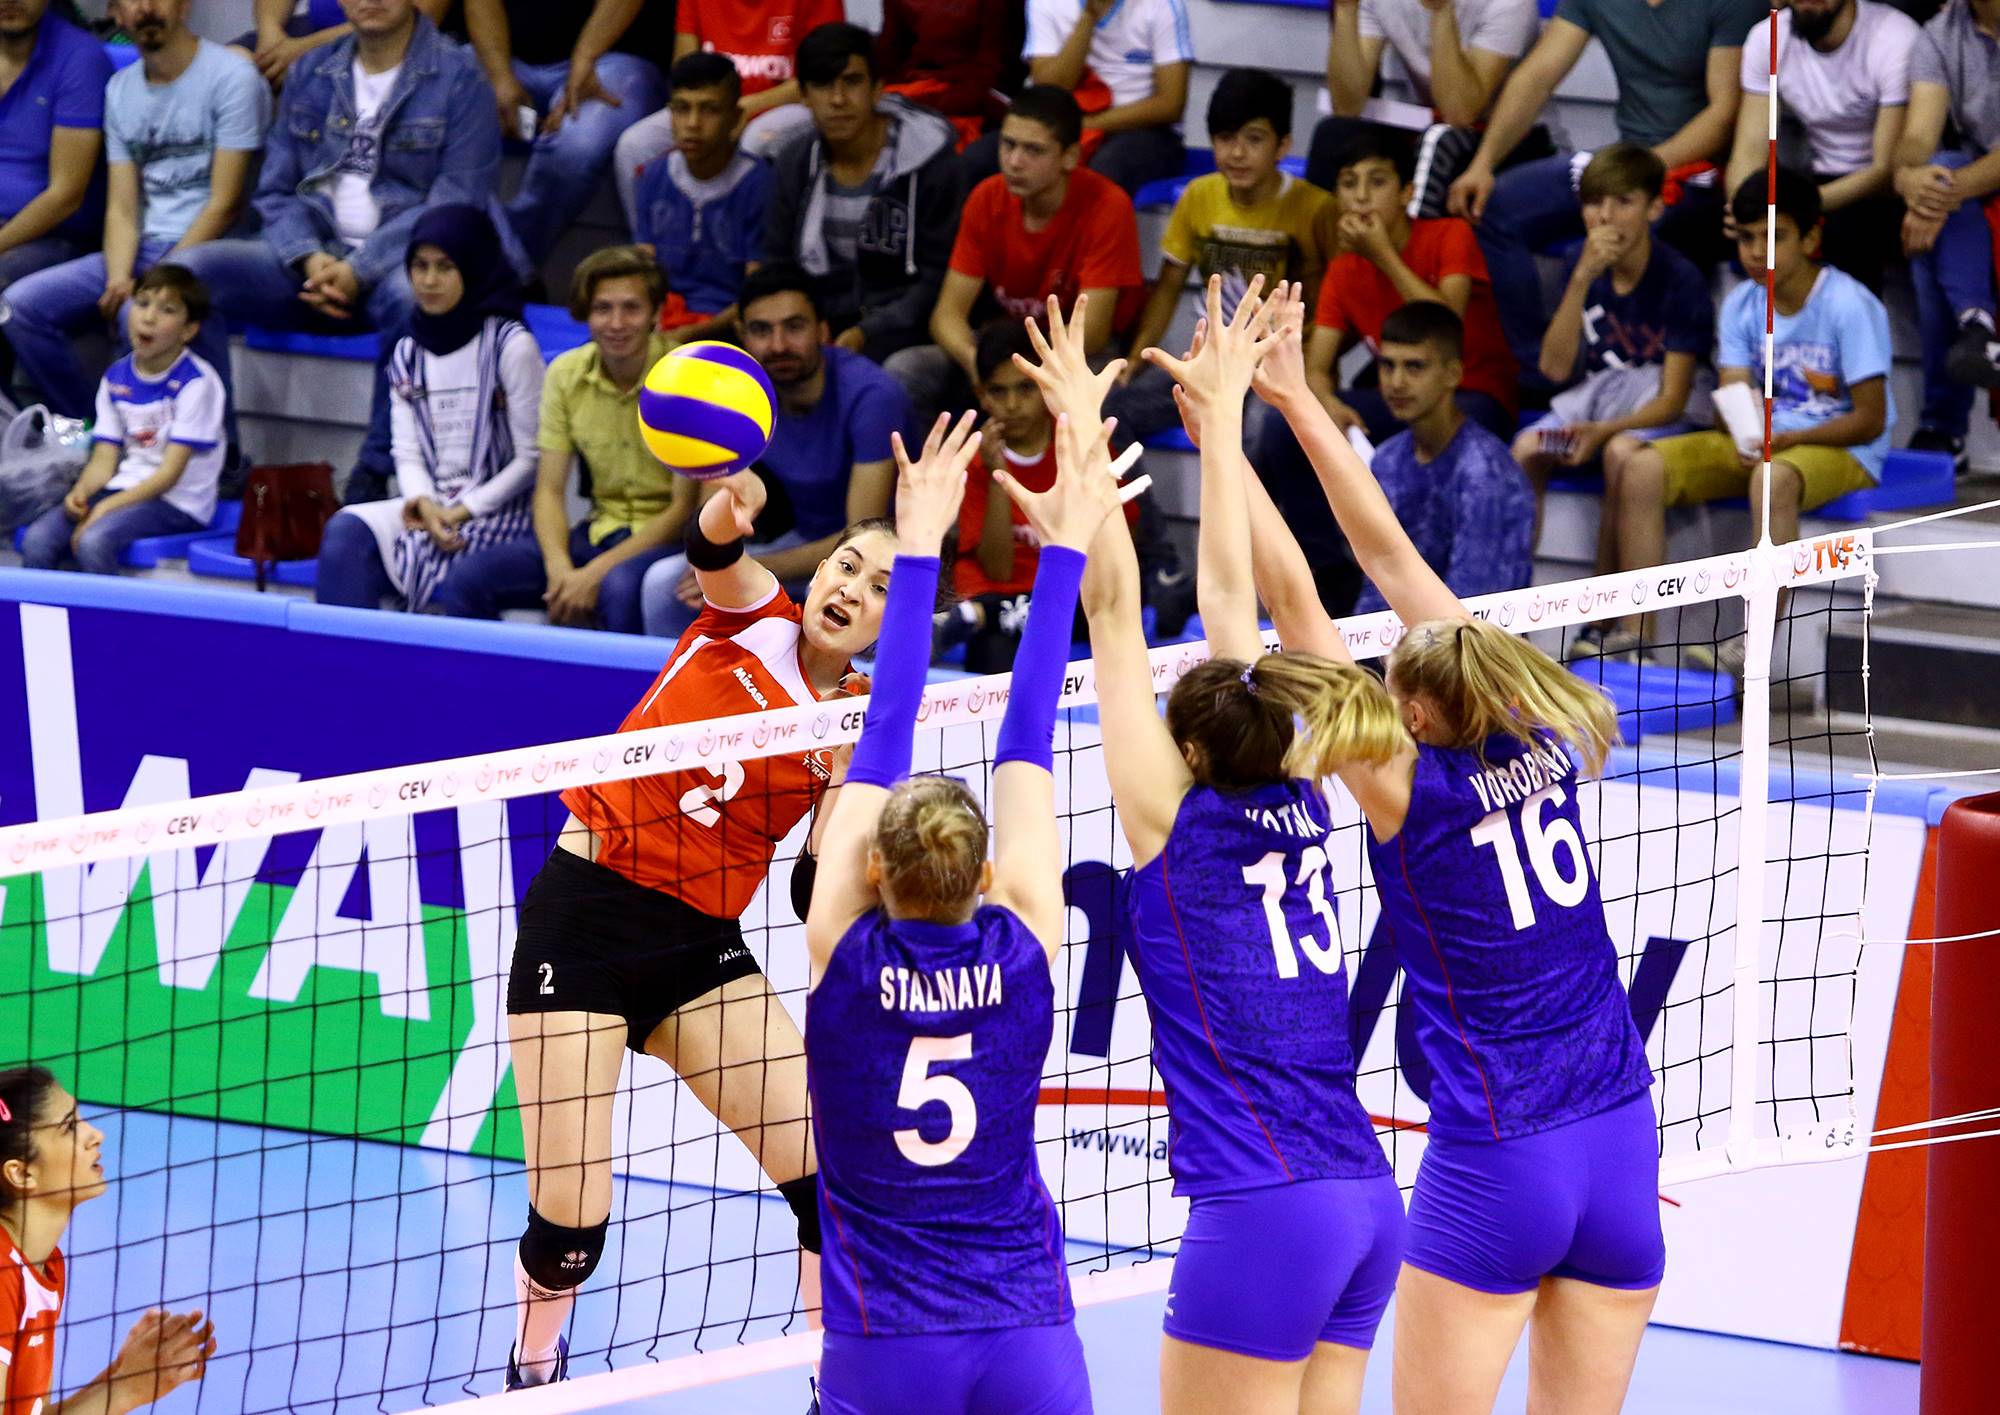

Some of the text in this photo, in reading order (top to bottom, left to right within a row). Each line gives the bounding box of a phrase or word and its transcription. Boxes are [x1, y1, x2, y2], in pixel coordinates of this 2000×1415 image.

[1812, 536, 1854, 571] TVF
[167, 814, 201, 835] CEV
[269, 803, 294, 819] TVF
[326, 793, 353, 808] TVF
[398, 780, 431, 801] CEV
[496, 767, 523, 784] TVF
[553, 758, 580, 775] TVF
[623, 744, 656, 765] CEV
[719, 732, 744, 747] TVF
[773, 724, 798, 740] TVF
[934, 697, 960, 713] TVF
[1060, 675, 1085, 695] EV
[1151, 664, 1168, 678] VF
[1348, 631, 1371, 647] TVF
[1546, 598, 1569, 614] TVF
[1596, 590, 1619, 605] TVF
[1657, 576, 1687, 597] CEV
[678, 759, 746, 828] 2
[1470, 782, 1589, 931] 16
[0, 602, 517, 1154] WAY
[1241, 845, 1342, 979] 13
[538, 962, 555, 995] 2
[880, 963, 1002, 1012] STALNAYA
[893, 1032, 977, 1167] 5
